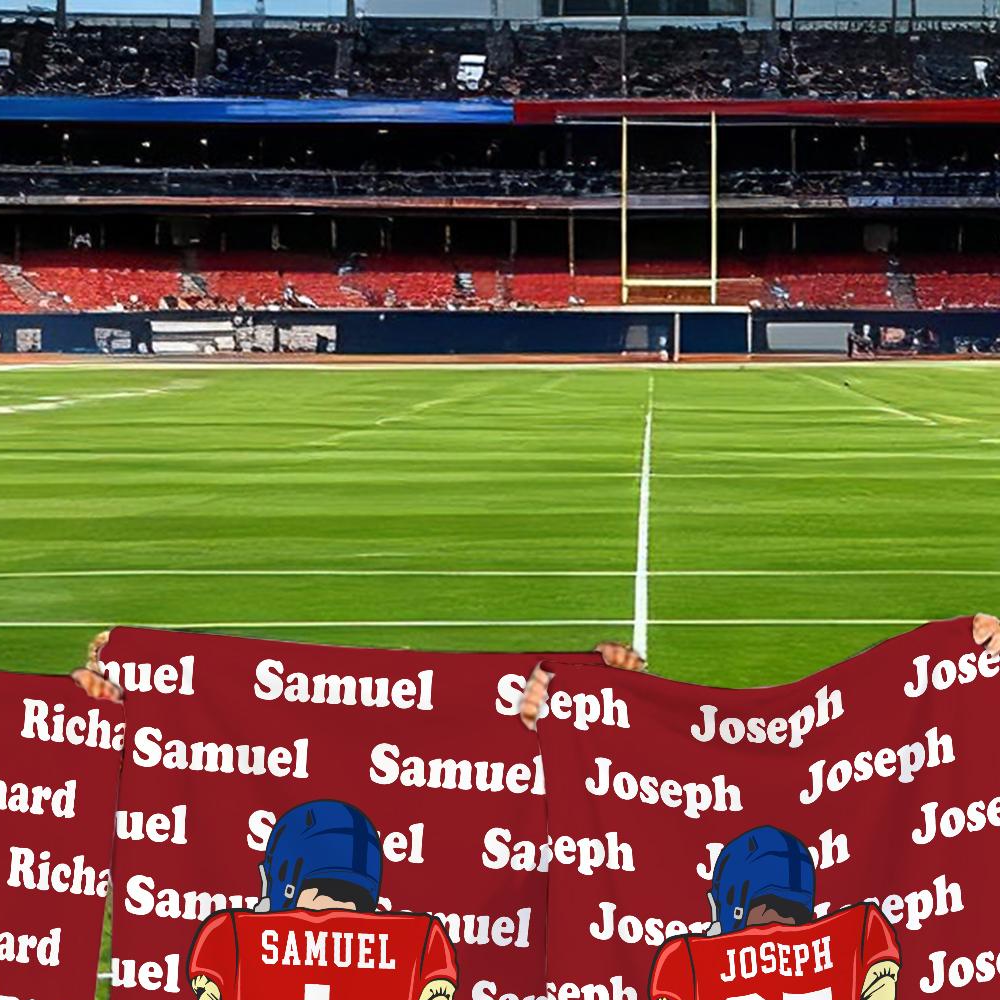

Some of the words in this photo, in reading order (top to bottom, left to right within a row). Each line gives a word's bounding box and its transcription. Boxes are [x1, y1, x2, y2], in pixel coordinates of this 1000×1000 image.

[254, 659, 433, 710] Samuel
[691, 685, 844, 748] Joseph
[133, 727, 308, 778] Samuel
[370, 743, 546, 795] Samuel
[585, 757, 743, 818] Joseph
[800, 727, 955, 804] Joseph
[590, 903, 711, 946] Jose
[262, 930, 395, 969] SAMUEL
[721, 936, 833, 982] JOSEPH
[920, 951, 1000, 993] Jos
